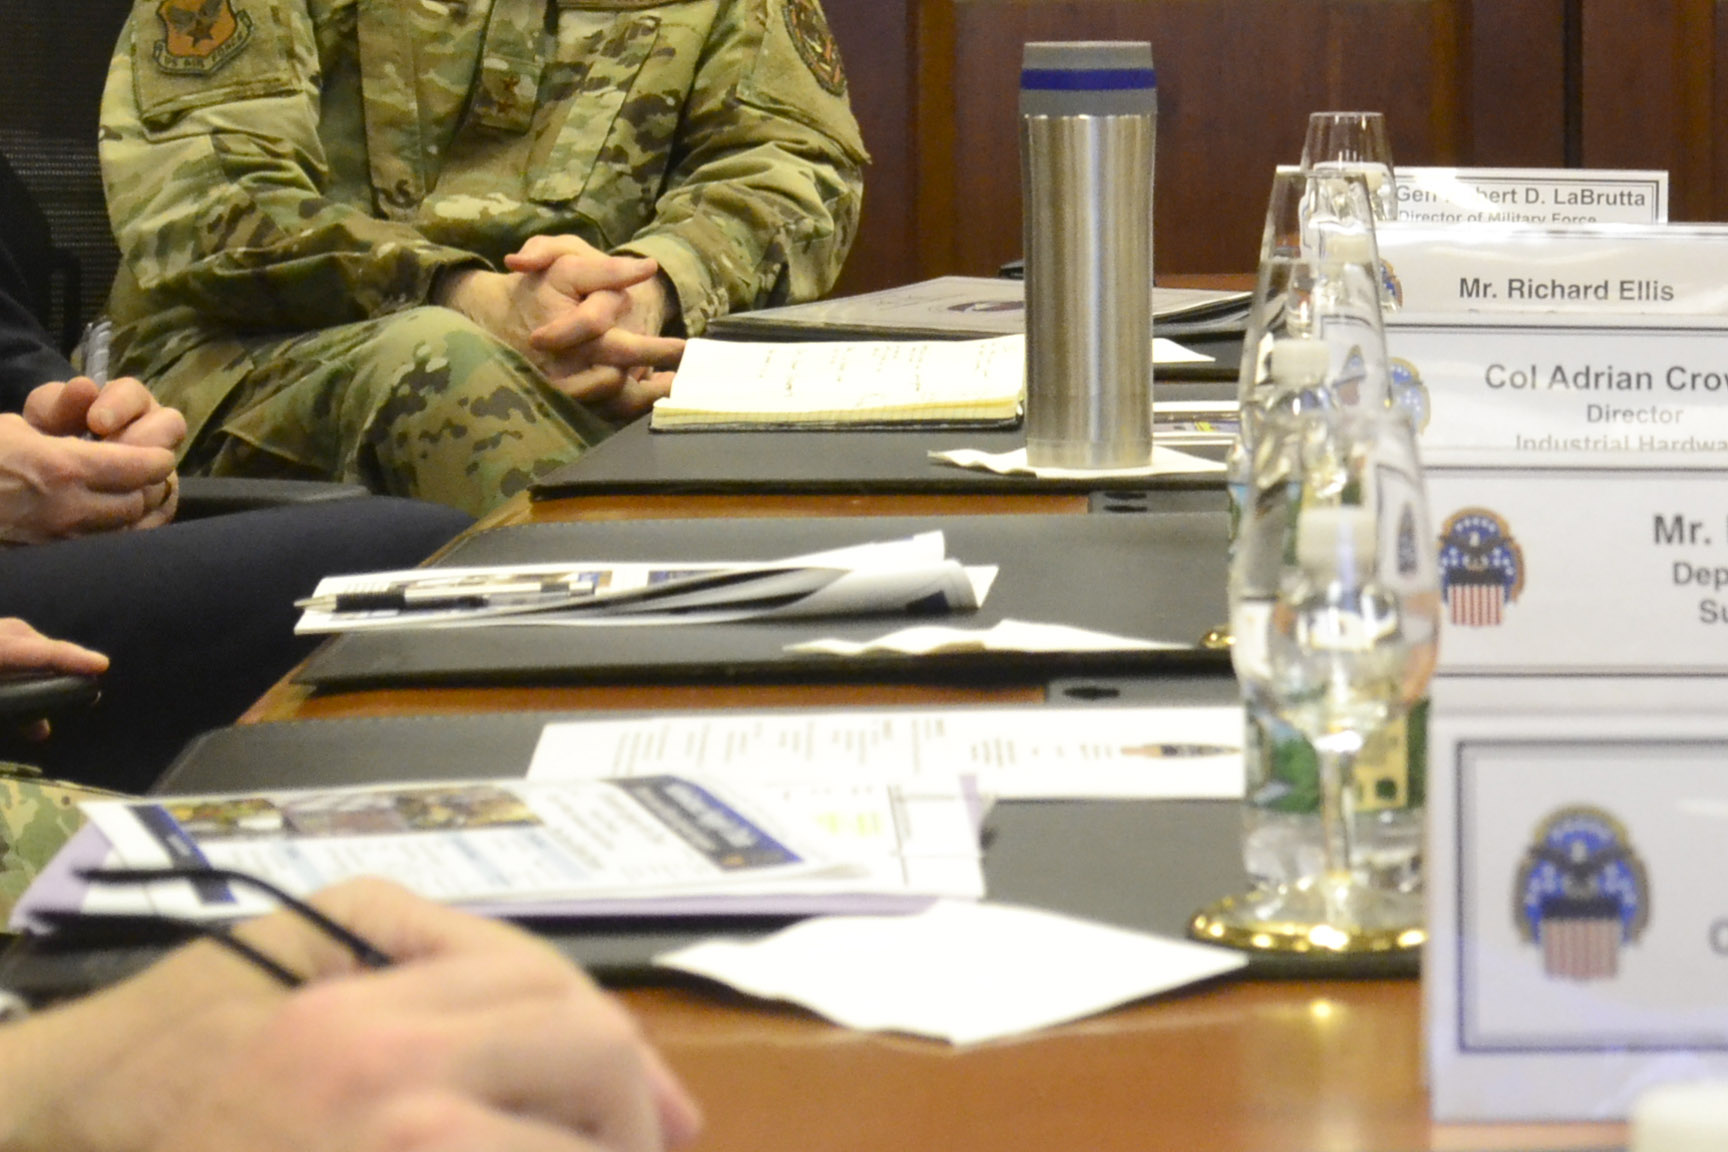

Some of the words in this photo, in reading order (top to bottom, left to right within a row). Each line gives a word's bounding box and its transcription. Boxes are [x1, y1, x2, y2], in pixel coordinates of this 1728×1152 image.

[1525, 188, 1546, 204] D.
[1553, 188, 1646, 206] LaBrutta
[1459, 277, 1497, 299] Mr.
[1507, 278, 1609, 301] Richard
[1618, 279, 1675, 302] Ellis
[1485, 363, 1538, 390] Col
[1550, 364, 1653, 391] Adrian
[1586, 403, 1685, 424] Director
[1515, 434, 1630, 451] Industrial
[1653, 514, 1712, 546] Mr.
